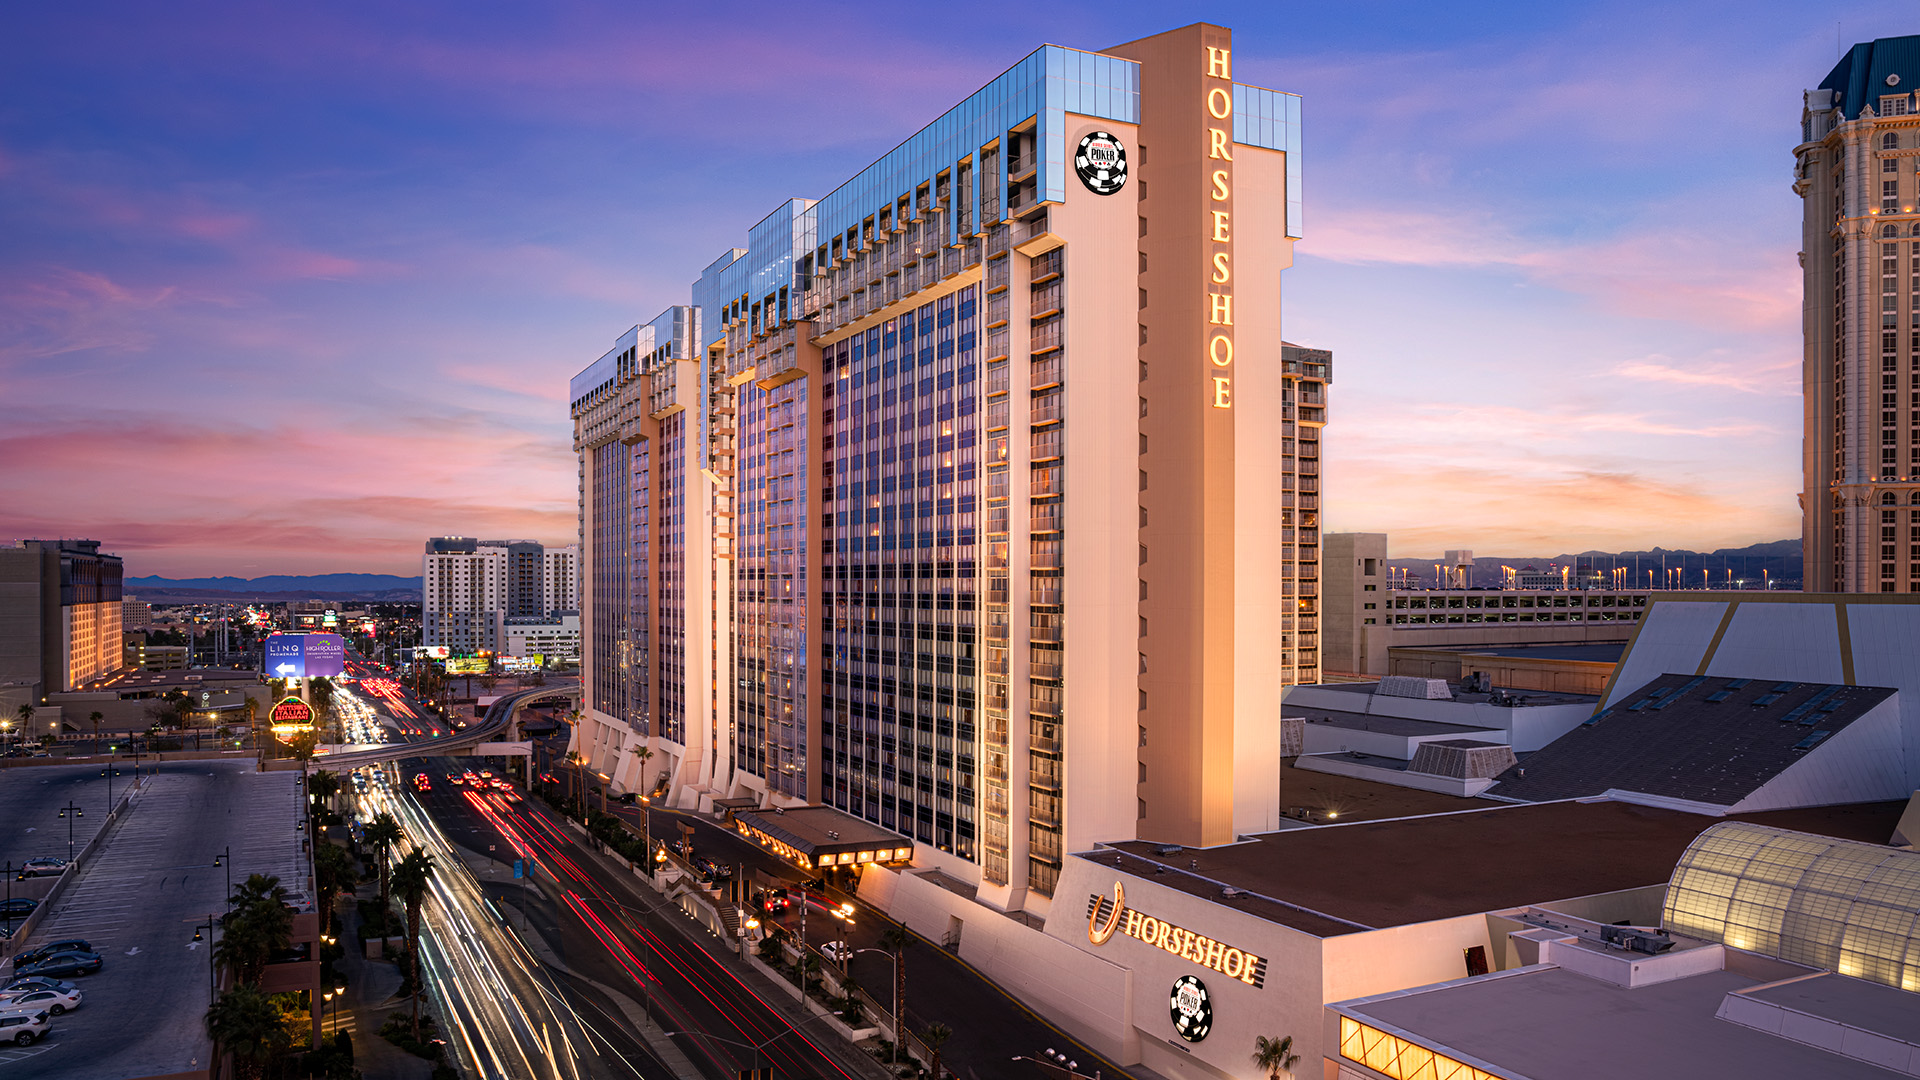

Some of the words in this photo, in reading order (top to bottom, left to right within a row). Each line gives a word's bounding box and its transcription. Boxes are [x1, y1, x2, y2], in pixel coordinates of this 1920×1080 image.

[1091, 149, 1115, 162] POKER
[1205, 46, 1234, 409] HORSESHOE
[1124, 909, 1258, 985] HORSESHOE
[1180, 992, 1198, 1010] POKER
